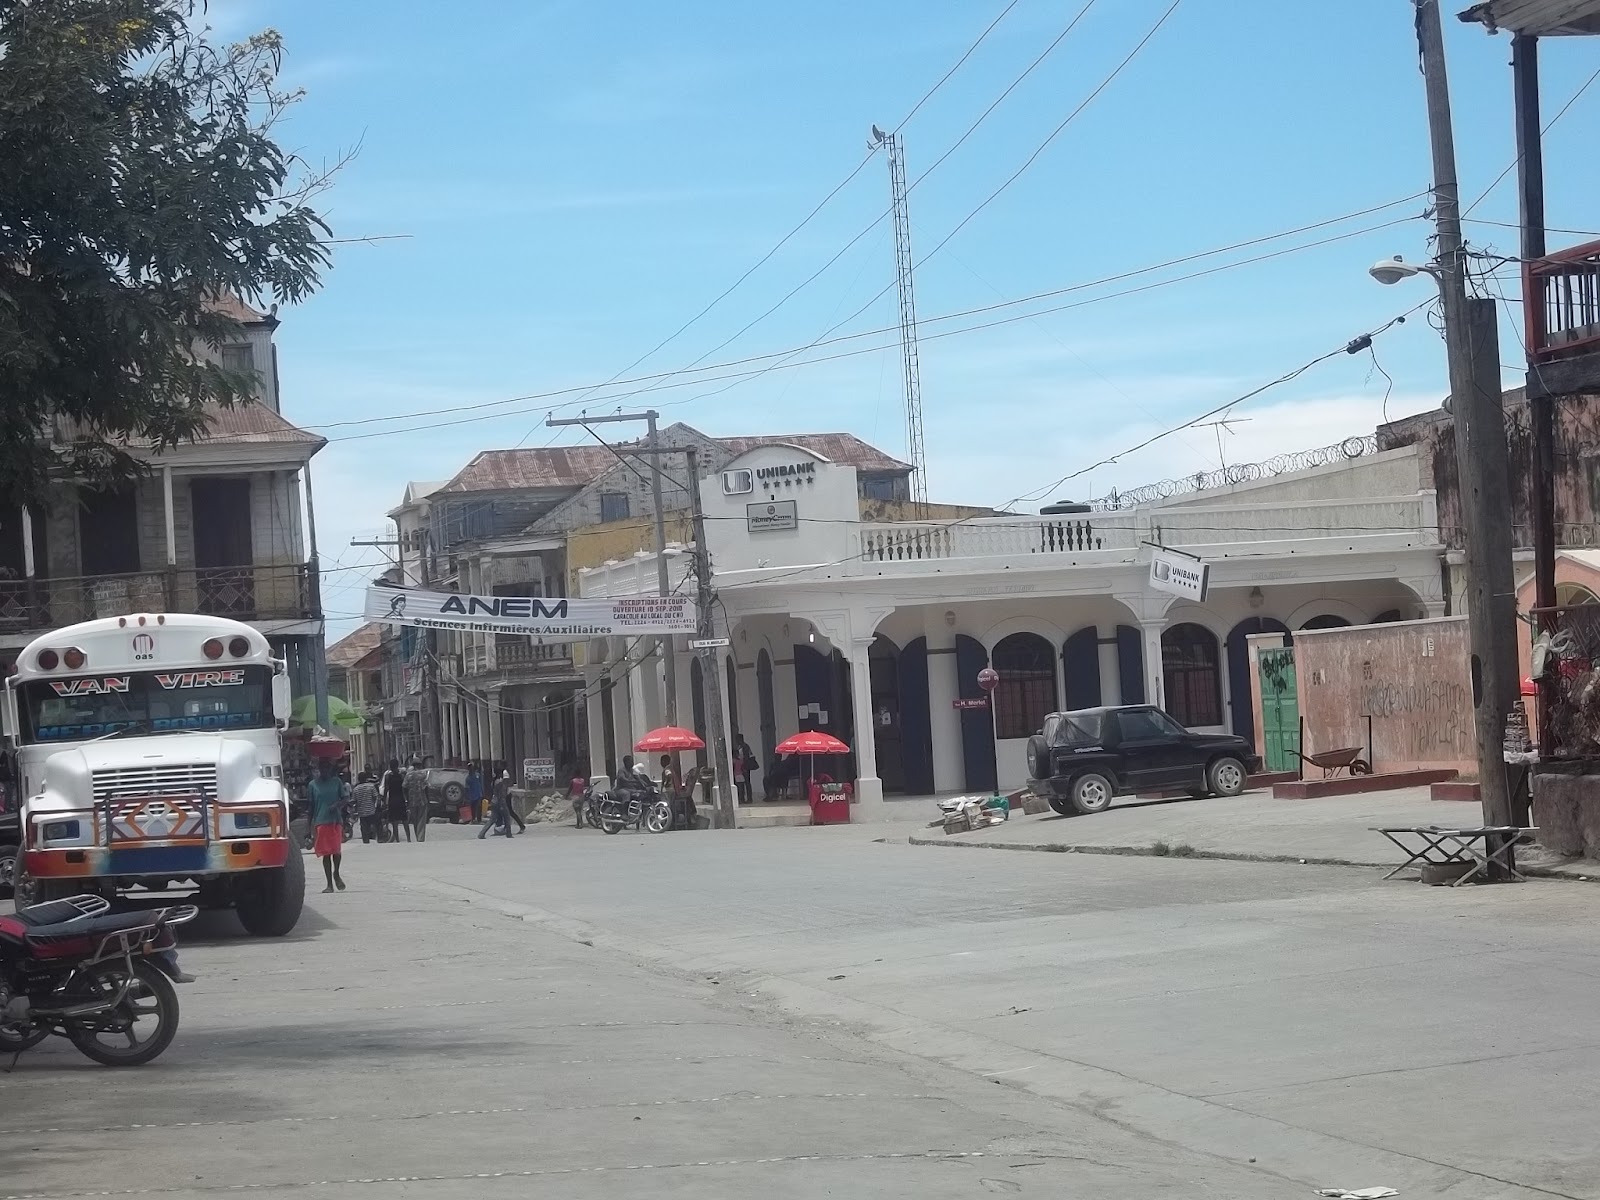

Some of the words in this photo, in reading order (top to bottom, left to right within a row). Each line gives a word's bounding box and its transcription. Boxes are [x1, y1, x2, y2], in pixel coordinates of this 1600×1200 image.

[756, 462, 815, 479] UNIBANK
[1172, 567, 1200, 582] UNIBANK
[439, 595, 568, 619] ANEM
[413, 617, 467, 629] Sciences
[50, 676, 131, 697] VAN
[154, 669, 245, 690] VIRE
[820, 793, 846, 803] Digicel
